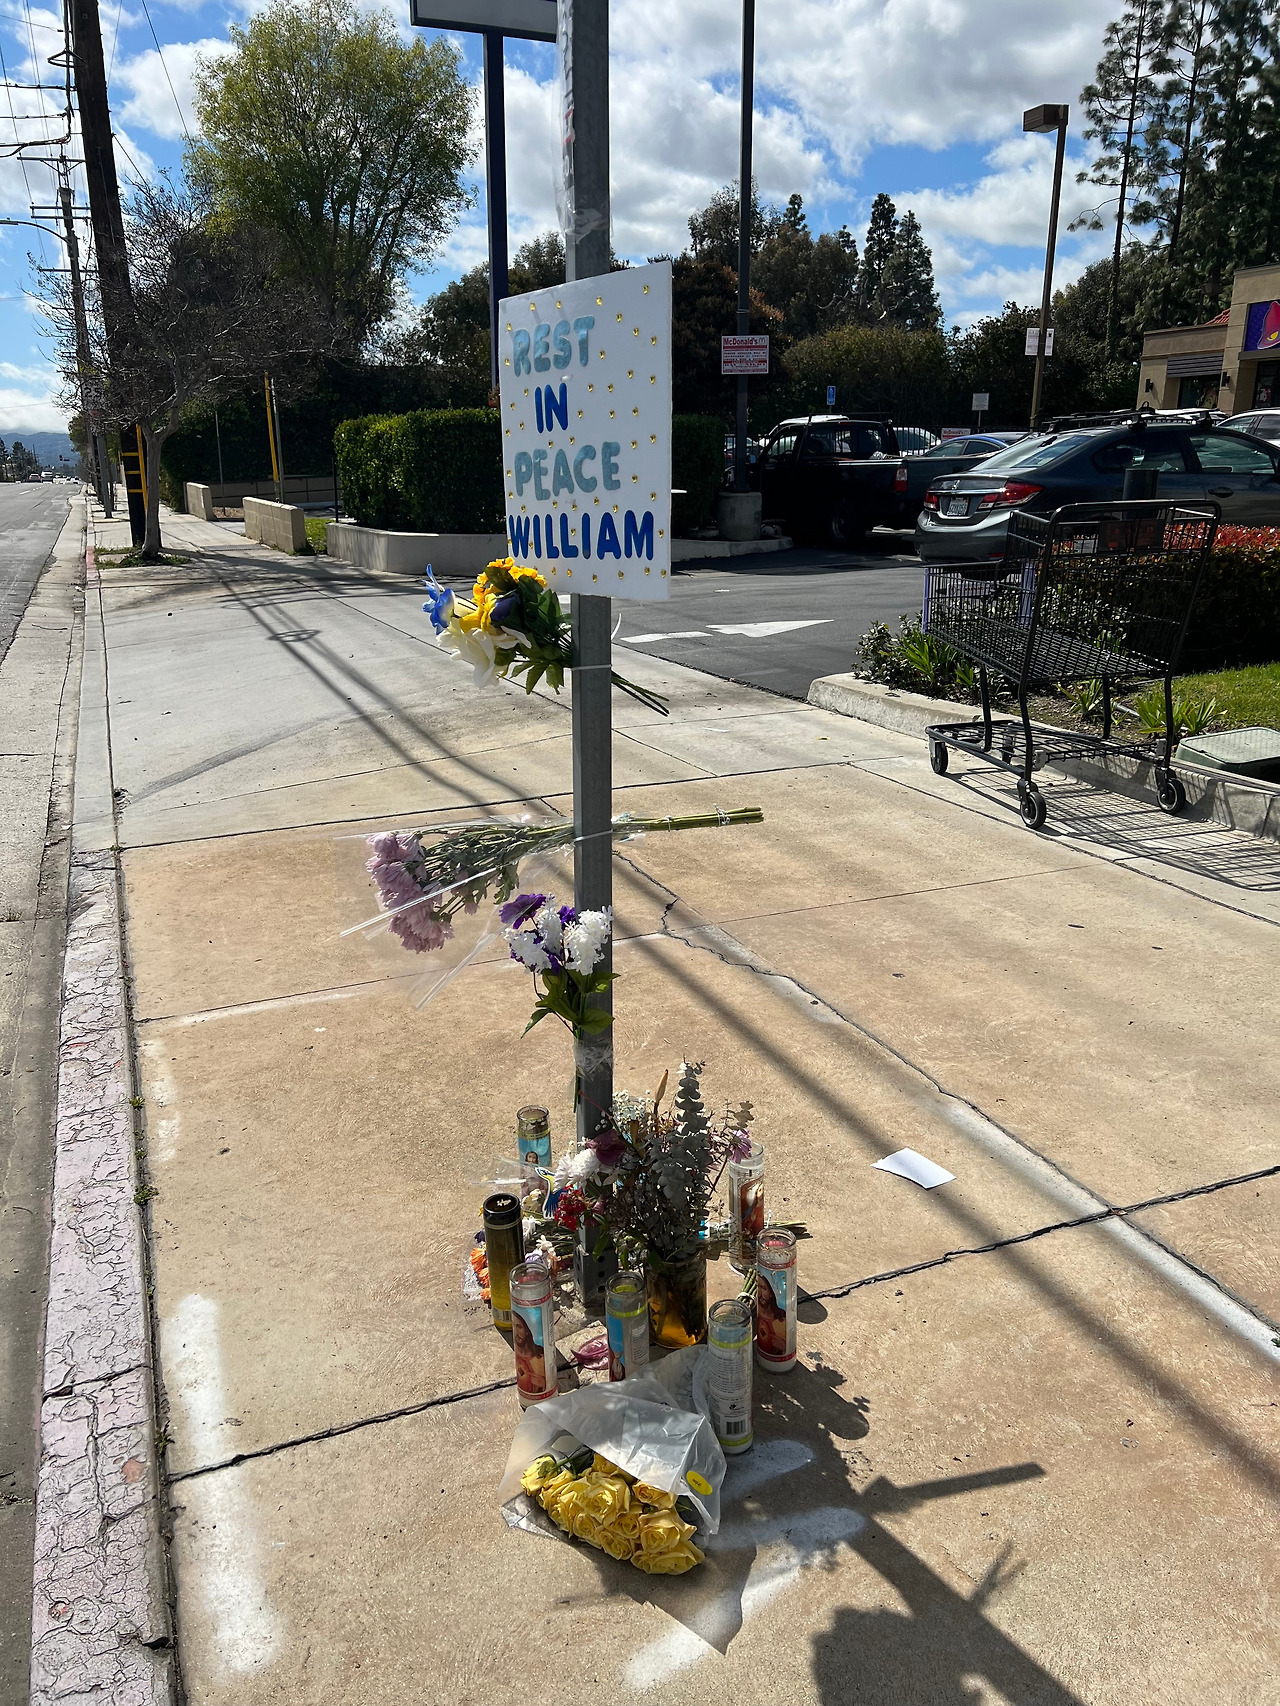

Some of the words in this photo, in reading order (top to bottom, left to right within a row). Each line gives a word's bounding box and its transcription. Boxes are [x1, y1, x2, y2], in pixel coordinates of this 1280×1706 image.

[513, 315, 595, 377] REST
[723, 337, 758, 345] McDonald's
[535, 382, 568, 433] IN
[514, 441, 621, 500] PEACE
[508, 509, 654, 560] WILLIAM
